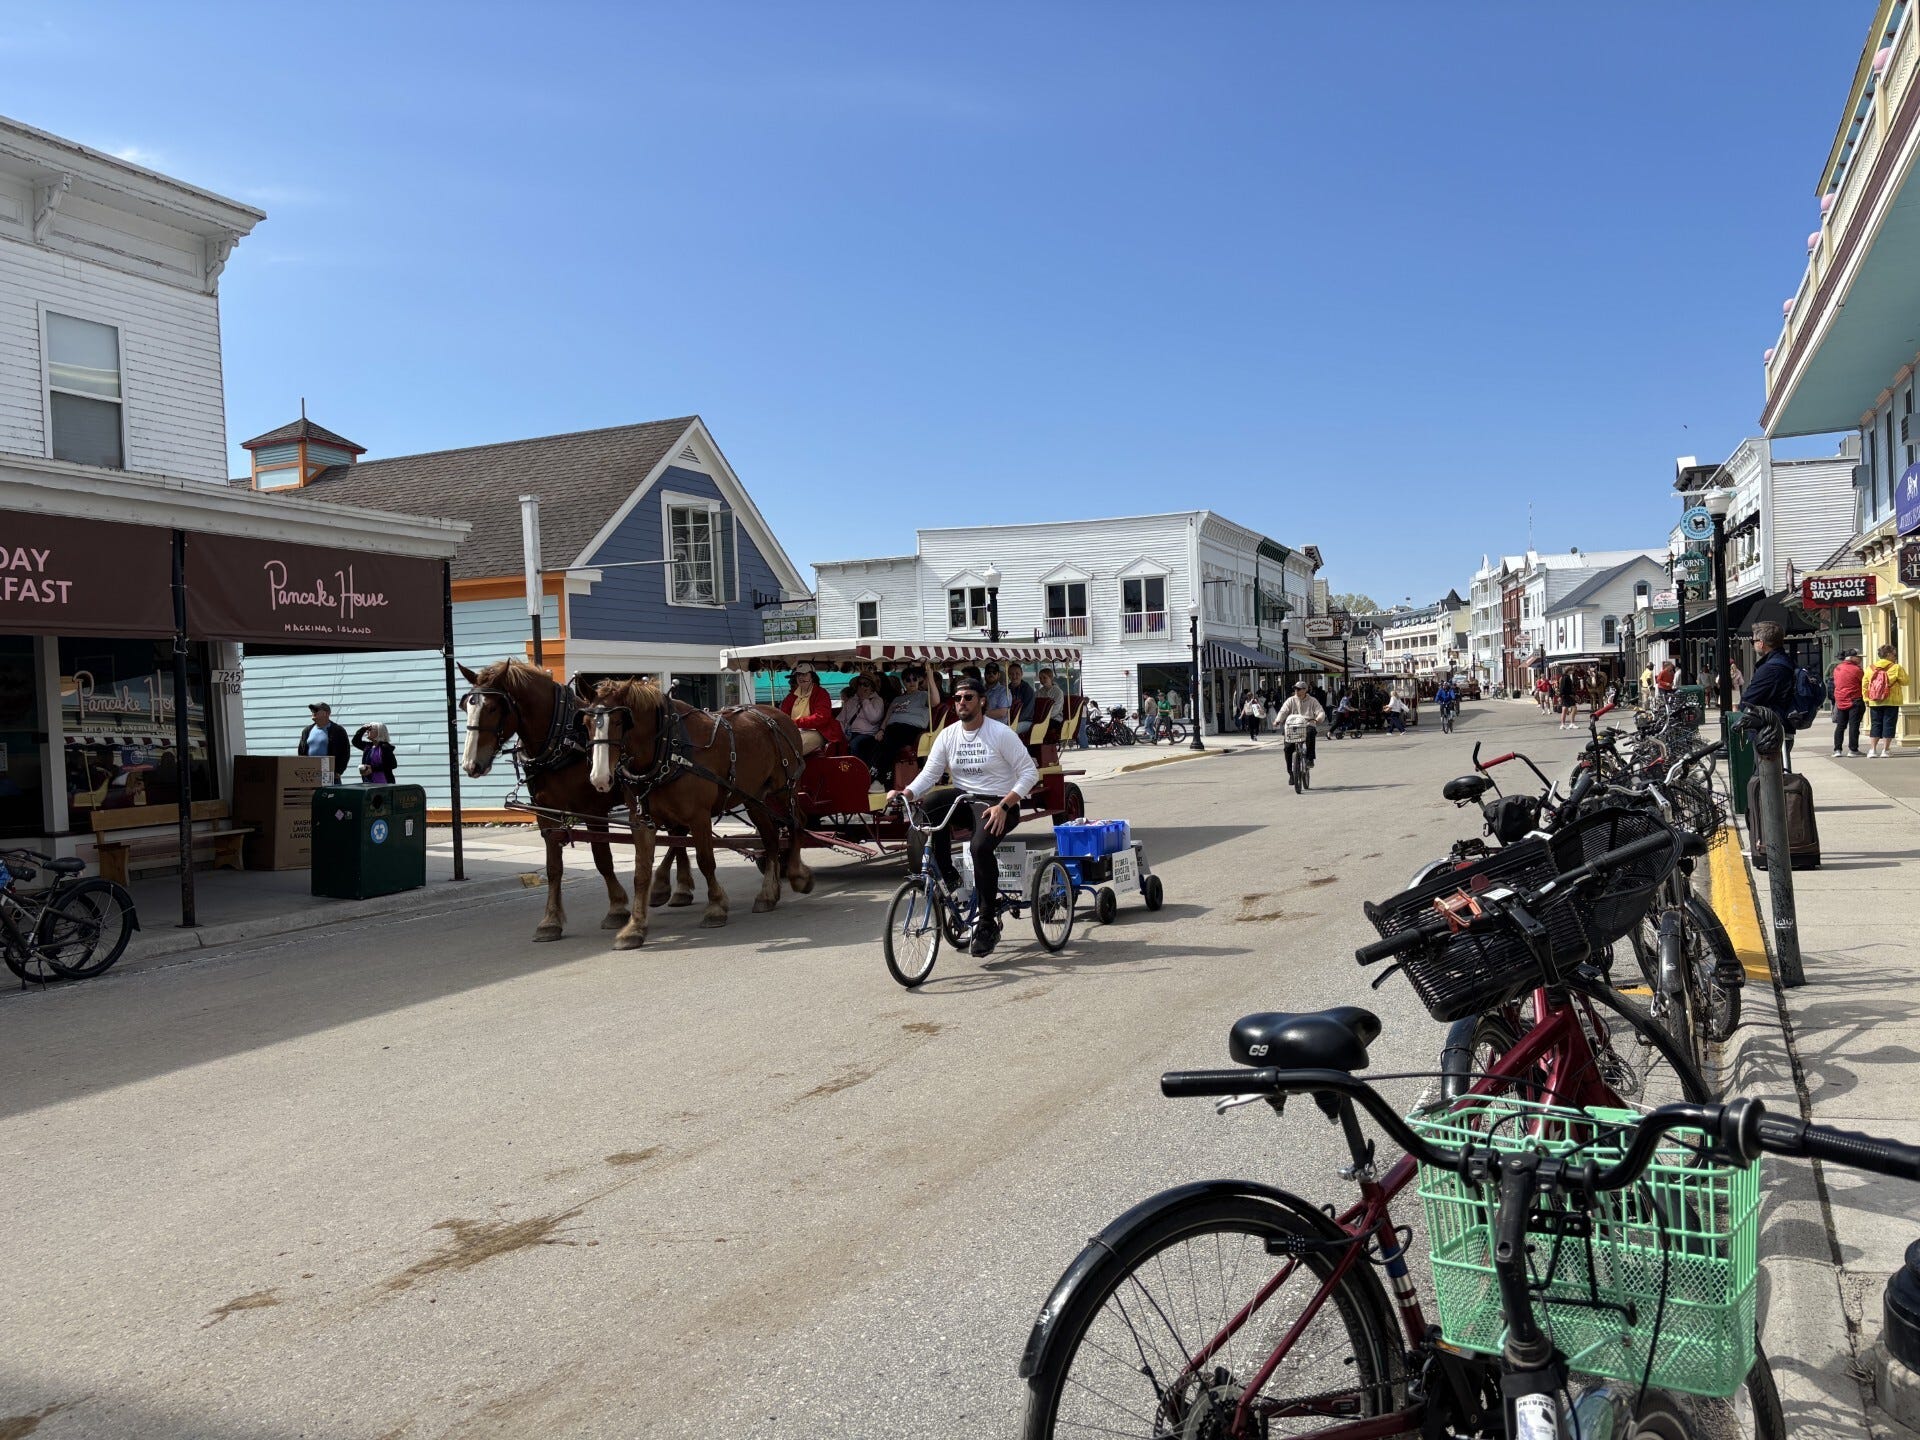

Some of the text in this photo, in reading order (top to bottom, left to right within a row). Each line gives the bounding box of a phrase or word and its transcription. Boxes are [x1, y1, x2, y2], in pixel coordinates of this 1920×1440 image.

[0, 546, 50, 572] DAY
[0, 576, 72, 604] FAST
[264, 560, 388, 620] Pancake House
[284, 624, 372, 634] MACKINAC ISLAND
[218, 671, 241, 682] 7245
[73, 670, 141, 720] Pancake
[1518, 1400, 1556, 1411] PRIVATE
